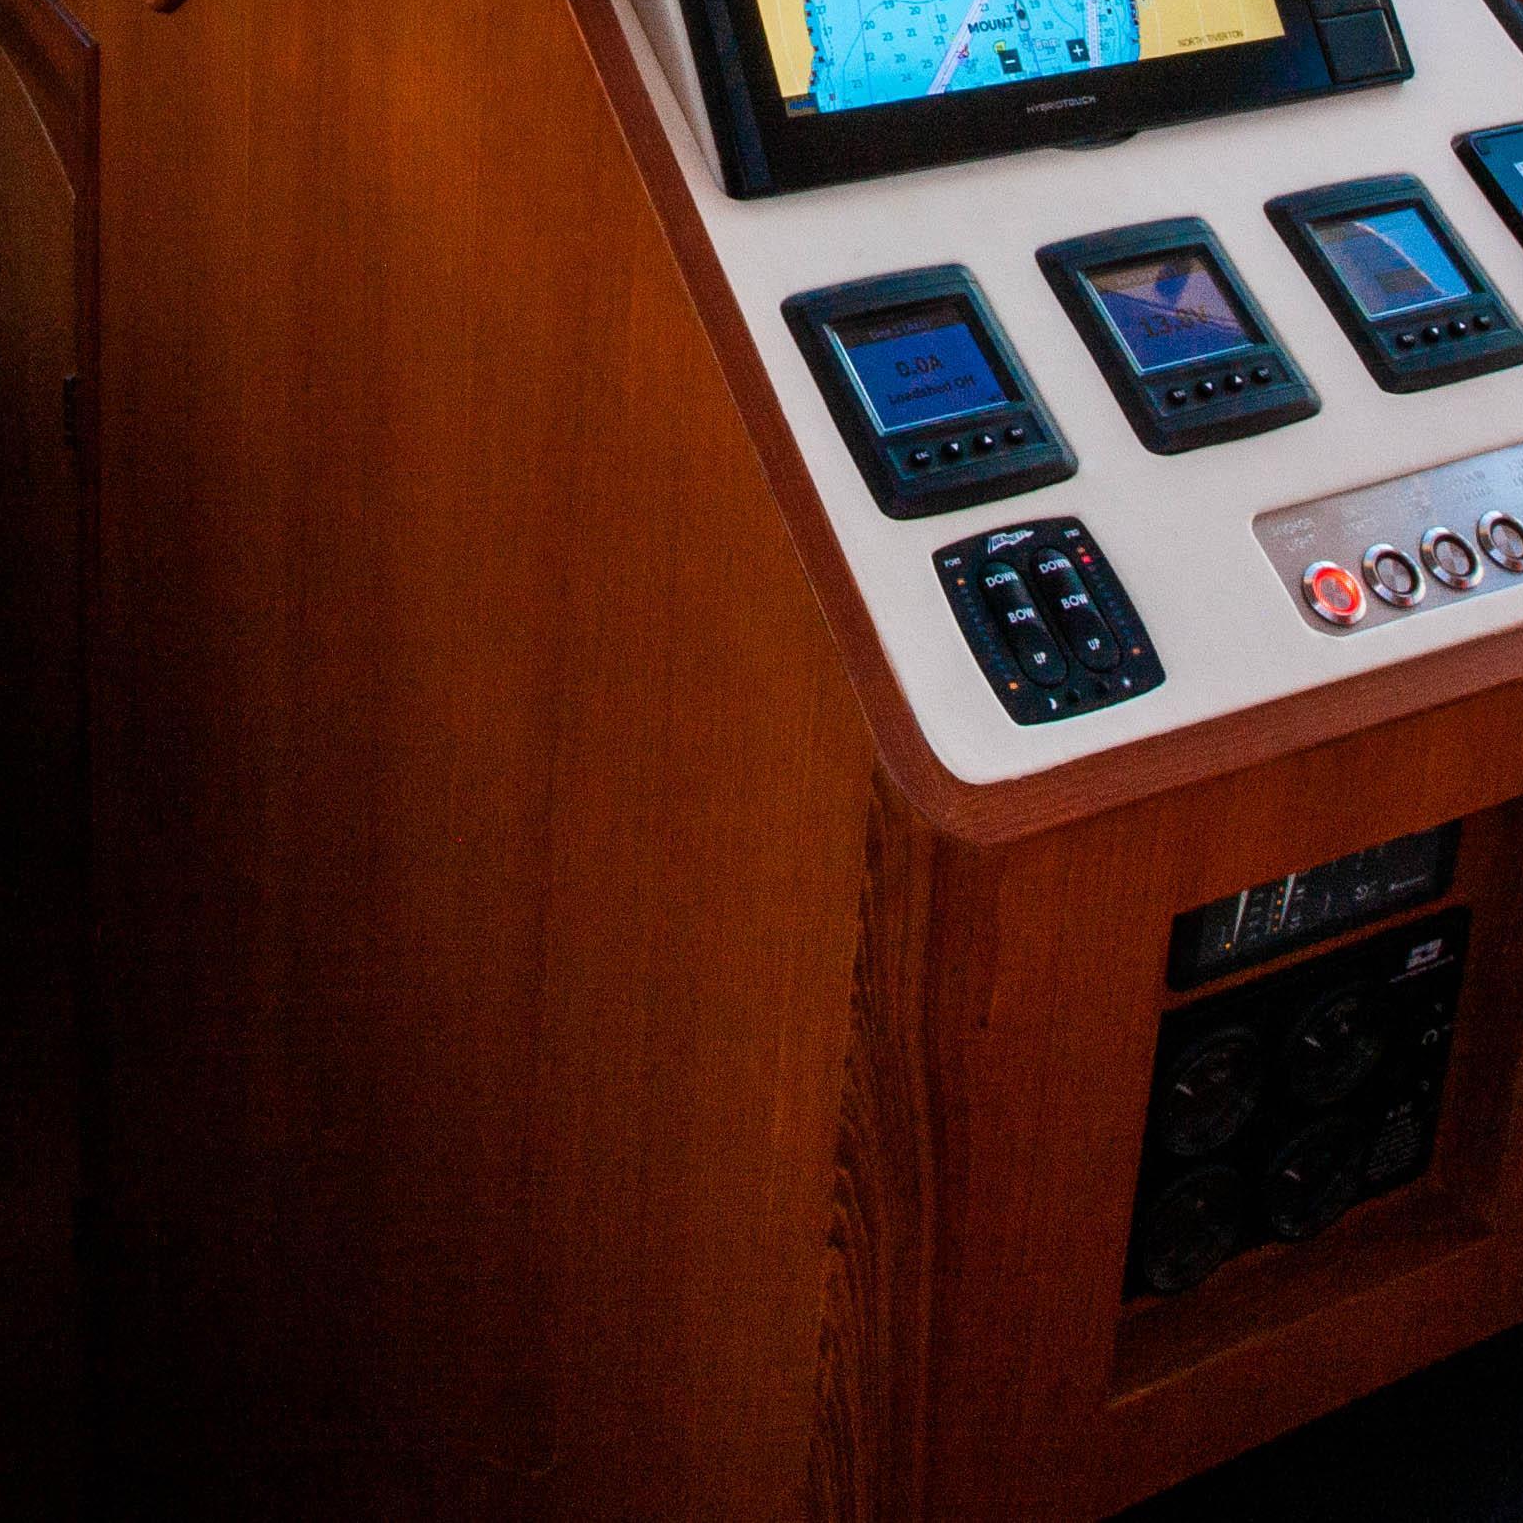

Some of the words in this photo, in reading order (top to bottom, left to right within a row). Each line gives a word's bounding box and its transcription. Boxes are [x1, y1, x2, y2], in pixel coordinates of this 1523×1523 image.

[909, 6, 921, 16] 20
[968, 17, 1014, 34] MOUNT
[882, 32, 894, 42] 23
[1039, 557, 1073, 574] DOWN
[985, 570, 1019, 588] DOWN
[1061, 593, 1089, 610] BOW
[1007, 607, 1036, 624] BOW
[1087, 637, 1102, 651] UP
[1033, 651, 1047, 665] UP
